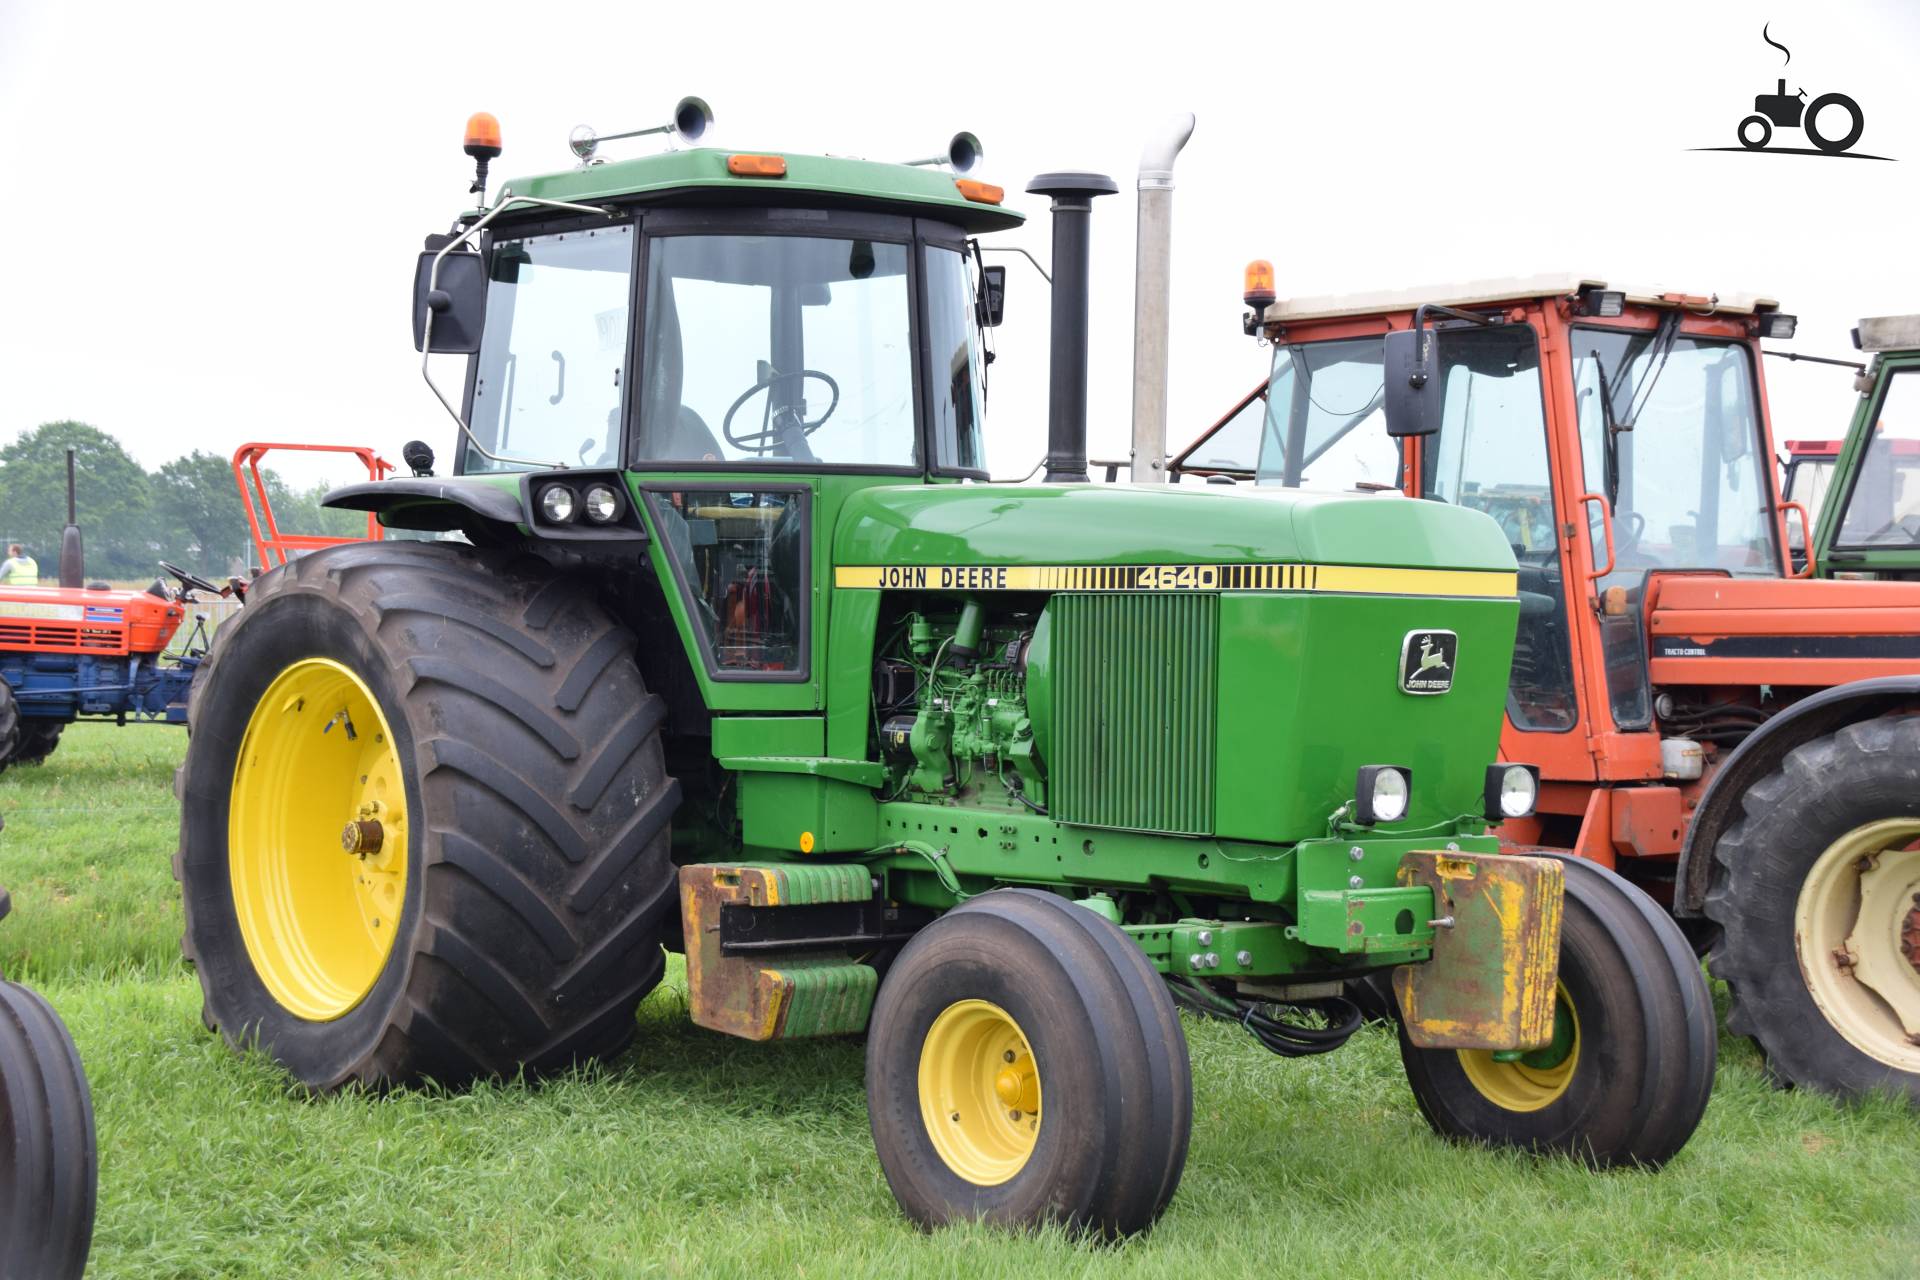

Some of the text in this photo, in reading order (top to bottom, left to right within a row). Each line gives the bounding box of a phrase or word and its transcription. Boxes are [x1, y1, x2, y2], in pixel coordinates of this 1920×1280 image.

[879, 567, 1007, 588] JOHN DEERE
[1138, 566, 1218, 590] 4640
[1406, 680, 1450, 688] JOHN DEERE
